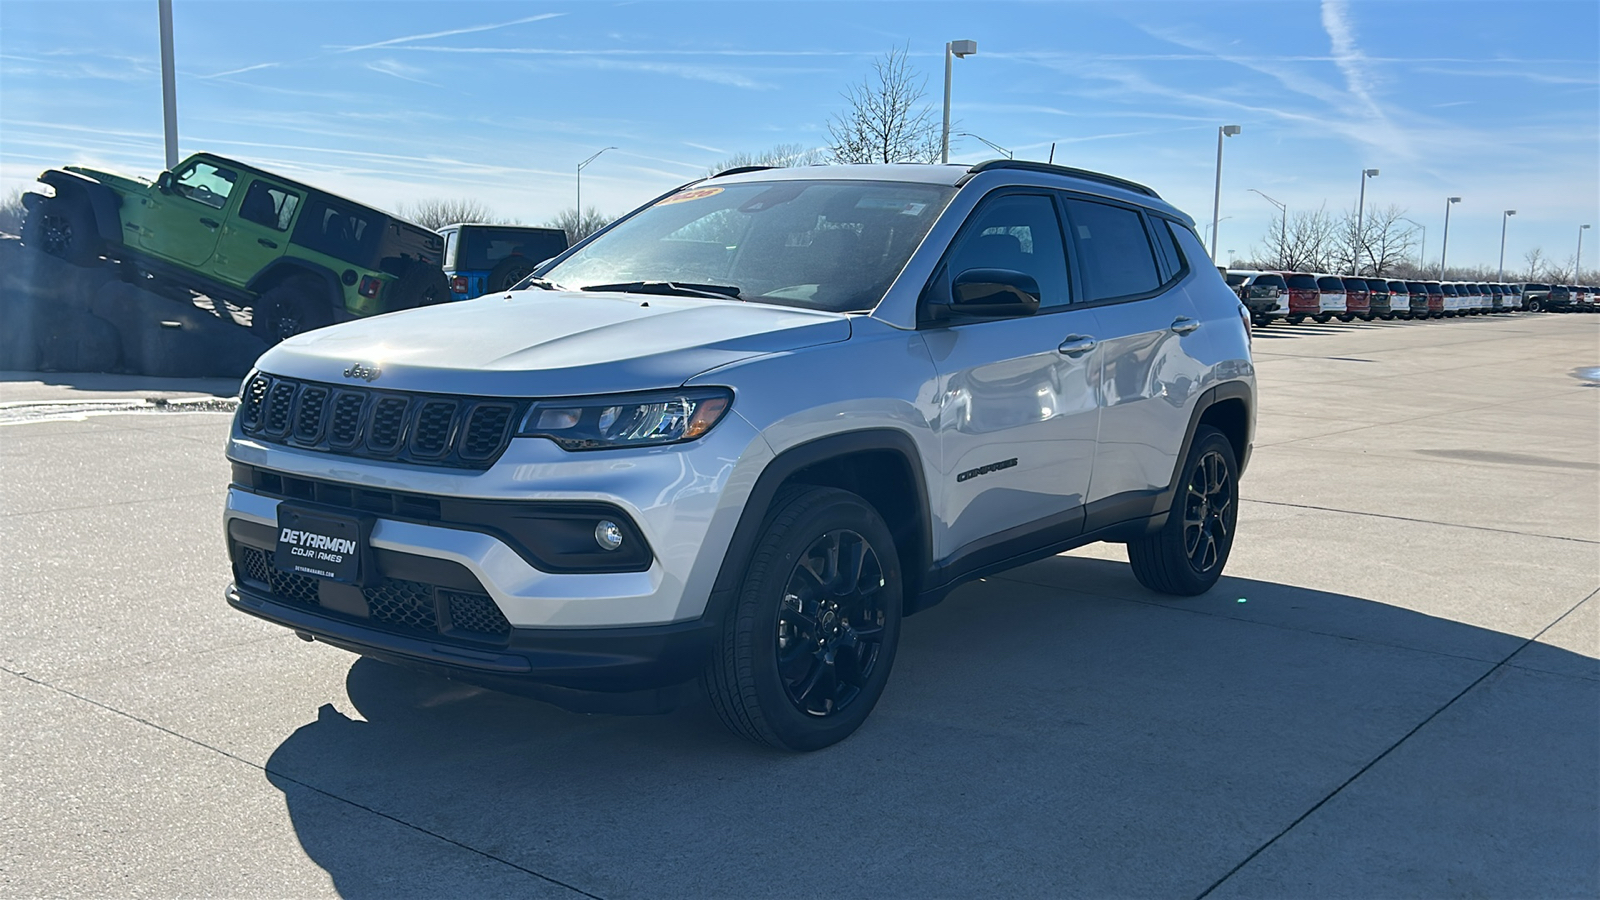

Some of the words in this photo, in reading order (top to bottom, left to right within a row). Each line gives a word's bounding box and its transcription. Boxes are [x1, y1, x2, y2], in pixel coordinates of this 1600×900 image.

[343, 362, 382, 383] Jeep
[957, 457, 1018, 482] COMPASS
[280, 528, 356, 555] DEYARMAN
[317, 552, 343, 563] AMES
